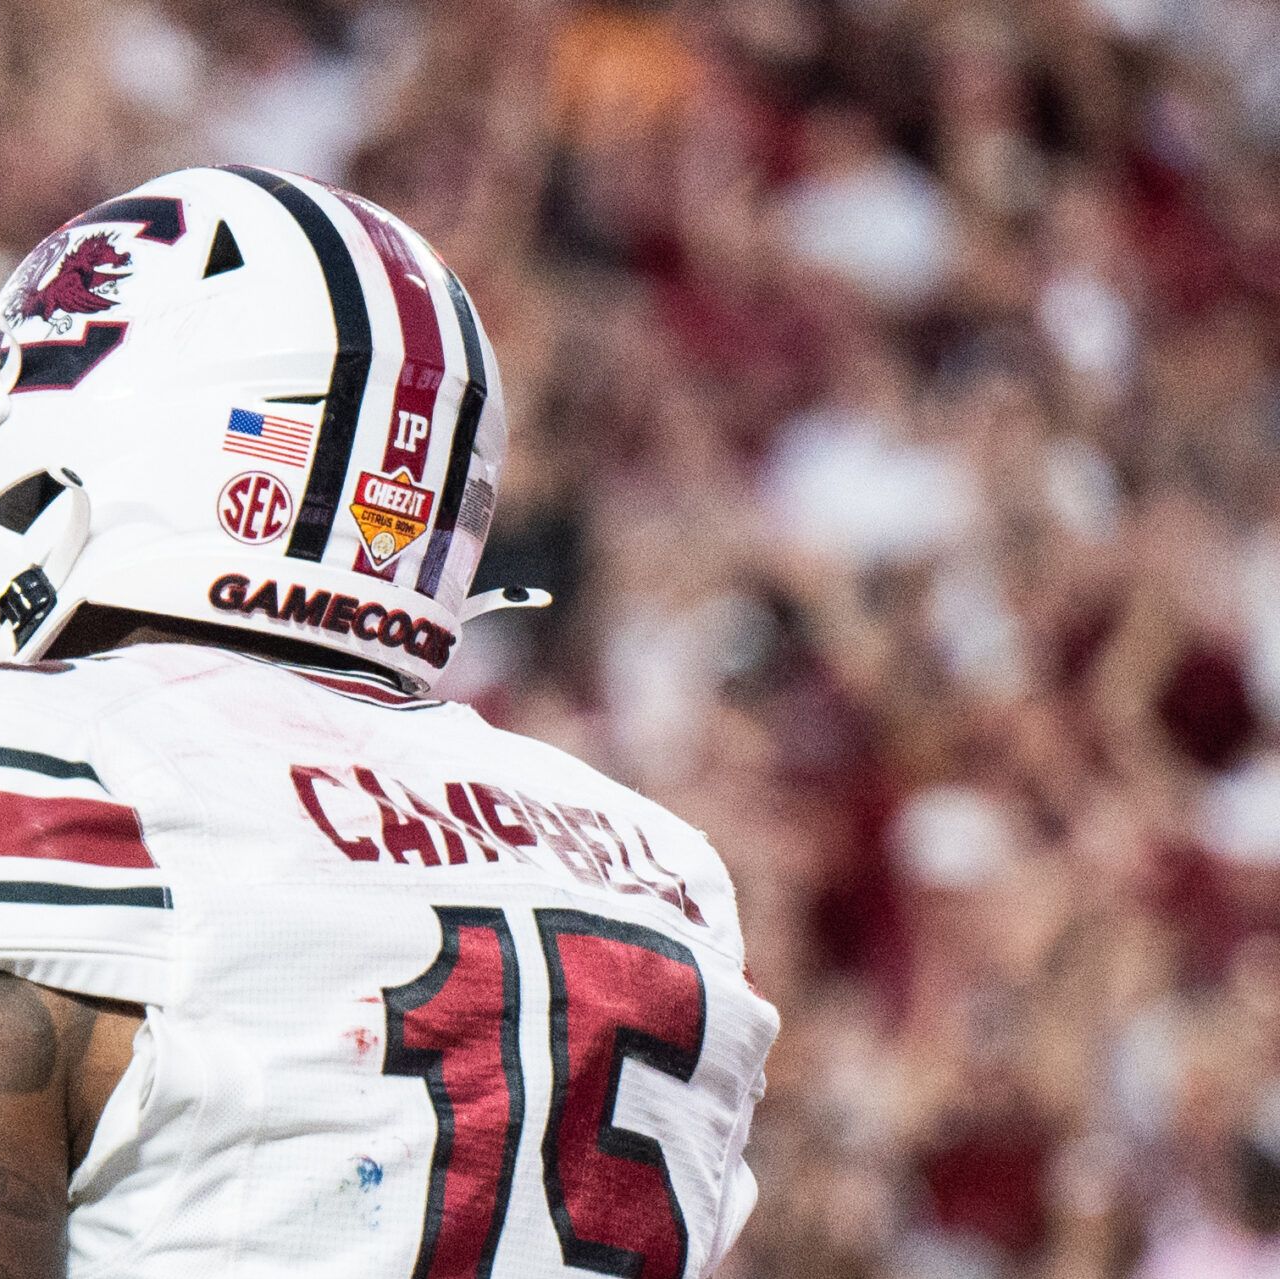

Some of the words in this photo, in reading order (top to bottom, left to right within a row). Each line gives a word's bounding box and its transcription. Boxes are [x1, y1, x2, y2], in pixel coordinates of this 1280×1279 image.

[394, 410, 428, 452] IP
[223, 476, 287, 540] SEC
[361, 510, 392, 527] CITRUS
[395, 519, 416, 535] BOWL
